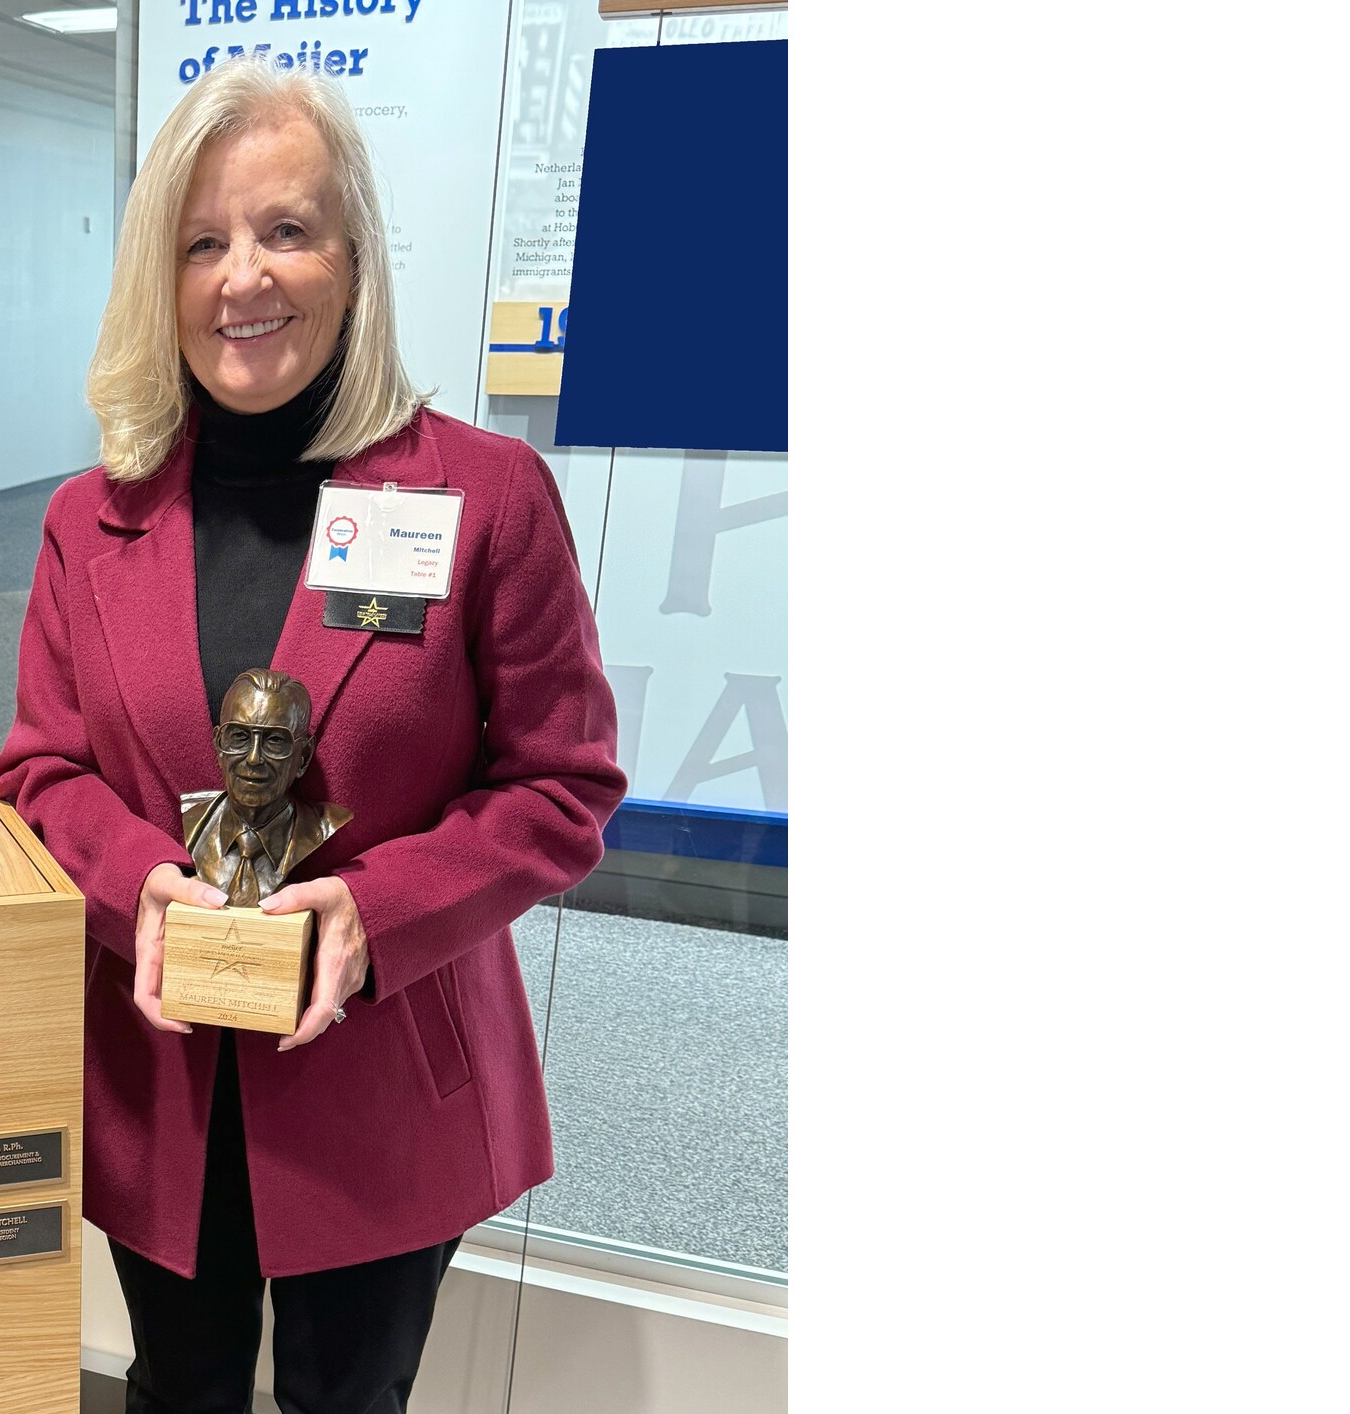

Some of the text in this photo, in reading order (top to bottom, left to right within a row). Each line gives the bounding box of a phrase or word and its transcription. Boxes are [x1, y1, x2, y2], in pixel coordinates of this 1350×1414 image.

[180, 0, 257, 26] The
[179, 46, 220, 84] of
[556, 178, 575, 190] Jan
[555, 209, 566, 217] to
[542, 224, 551, 232] at
[513, 237, 551, 249] Shortly
[515, 251, 567, 264] Michigan,
[512, 266, 571, 278] immigrants
[390, 528, 442, 540] Maureen
[180, 993, 279, 1012] MAUREEN MITCHELL
[3, 1142, 24, 1152] R.Ph.
